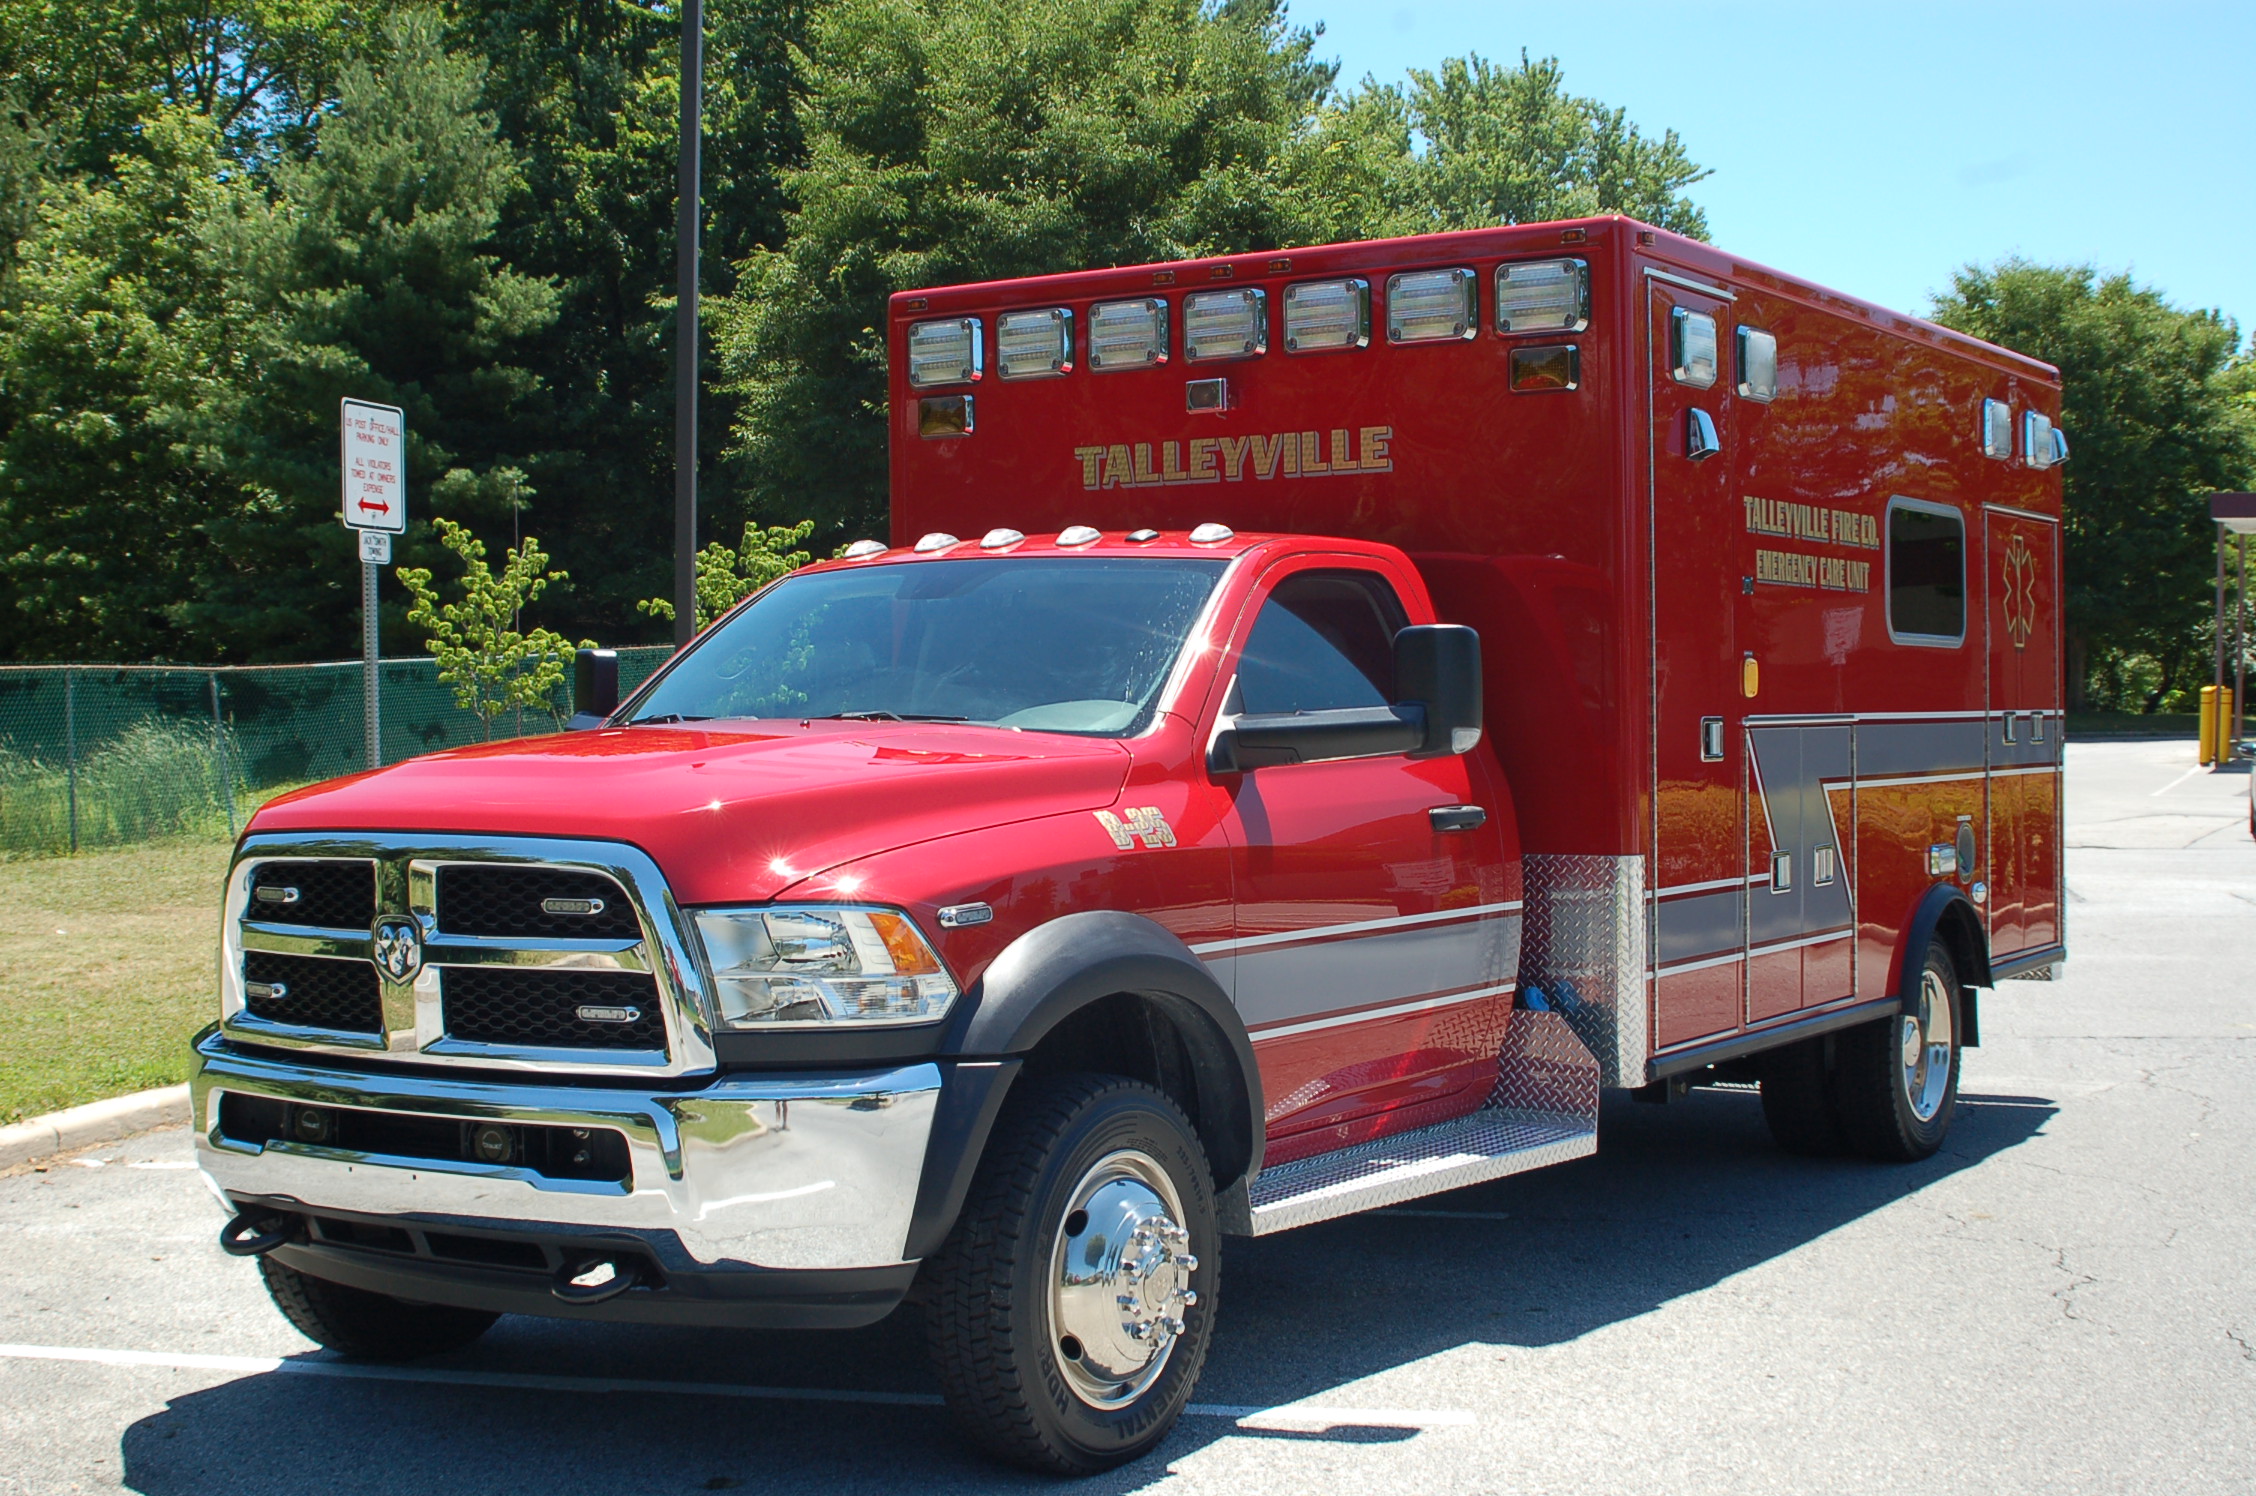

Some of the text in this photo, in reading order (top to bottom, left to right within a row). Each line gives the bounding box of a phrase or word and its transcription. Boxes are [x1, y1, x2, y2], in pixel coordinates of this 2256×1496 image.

[355, 419, 366, 430] POST
[356, 432, 389, 447] PARKING ONLY
[355, 457, 391, 471] ALL VIOLATORS
[1074, 425, 1393, 491] TALLEYVILLE
[351, 468, 396, 484] TOWED AT OWNERS
[363, 483, 384, 494] EXPENSE
[1744, 496, 1880, 550] TALLEYVILLE FIRE CO.
[1756, 549, 1870, 593] EMERGENCY CARE UNIT
[1092, 806, 1178, 851] B-25
